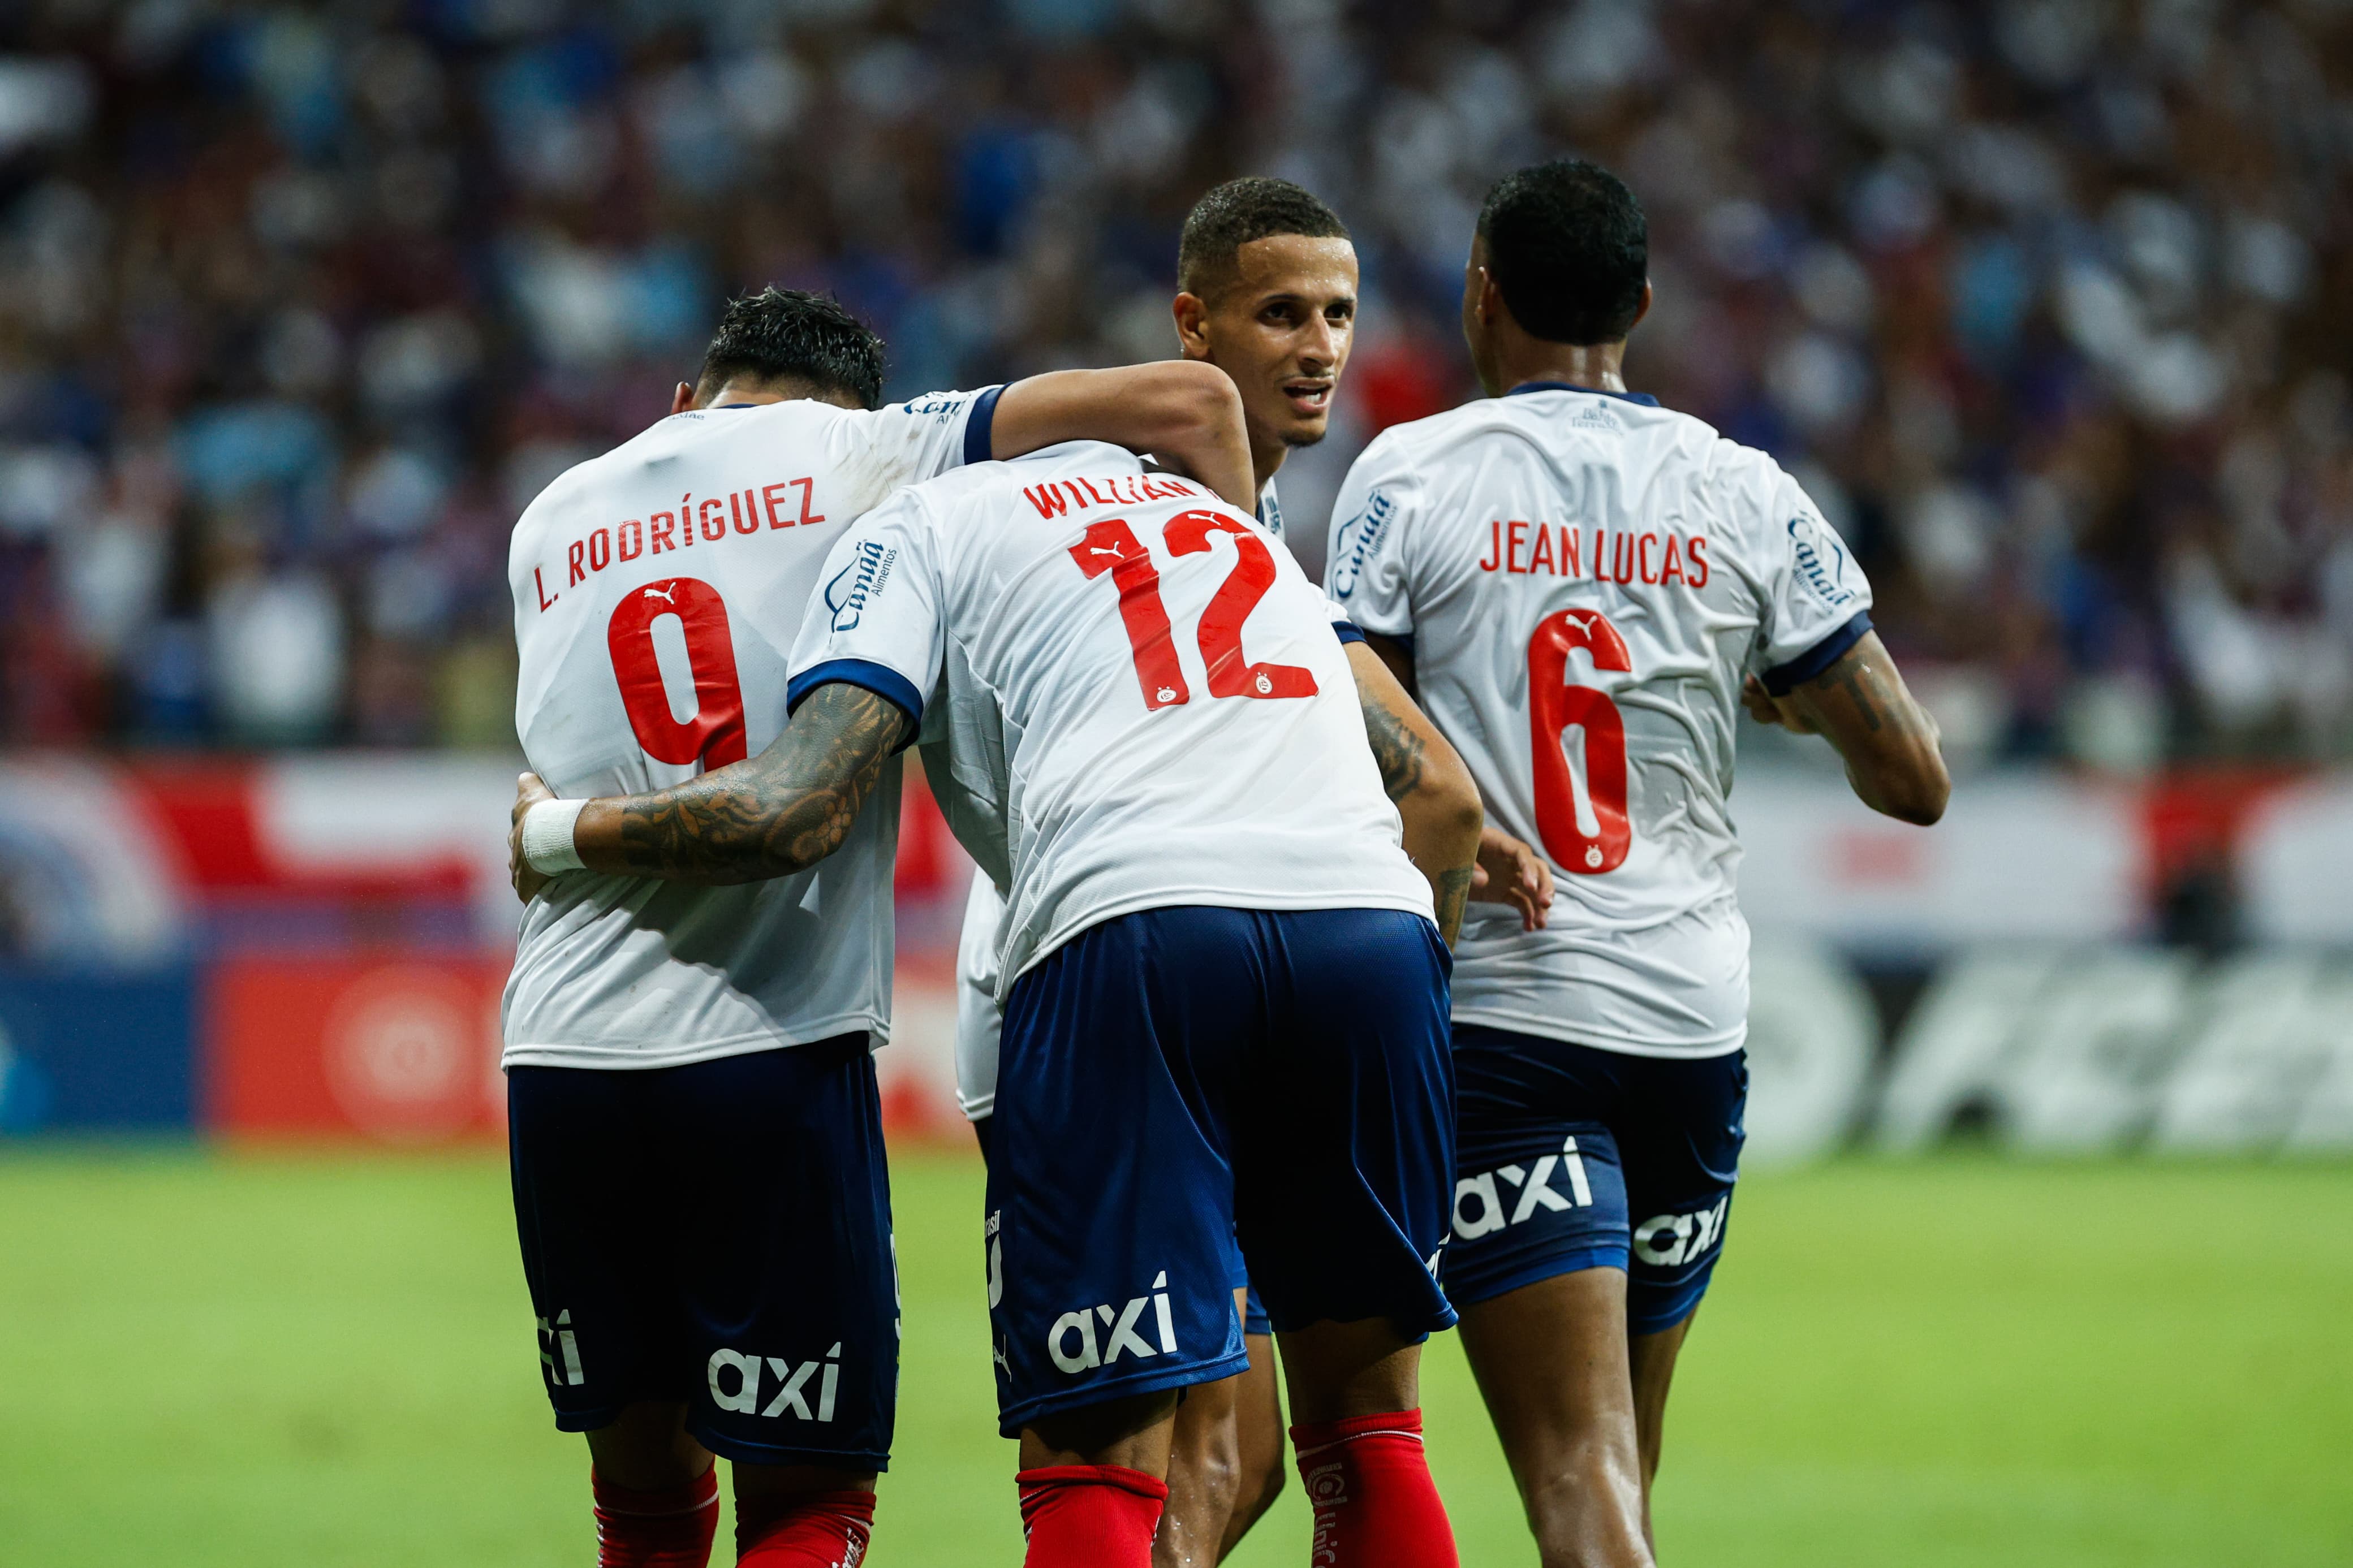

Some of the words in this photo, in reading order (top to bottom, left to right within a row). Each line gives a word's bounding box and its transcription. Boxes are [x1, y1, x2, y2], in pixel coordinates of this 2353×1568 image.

[534, 567, 559, 613] L.
[568, 476, 825, 588] RODRÍGUEZ
[1023, 474, 1198, 520] WILLIAN
[870, 549, 891, 597] Alimentos
[1479, 520, 1580, 578] JEAN
[1594, 529, 1709, 589] LUCAS
[1067, 508, 1320, 711] 12
[607, 576, 748, 772] 9
[1527, 608, 1632, 875] 6
[985, 1210, 1001, 1238] rasil
